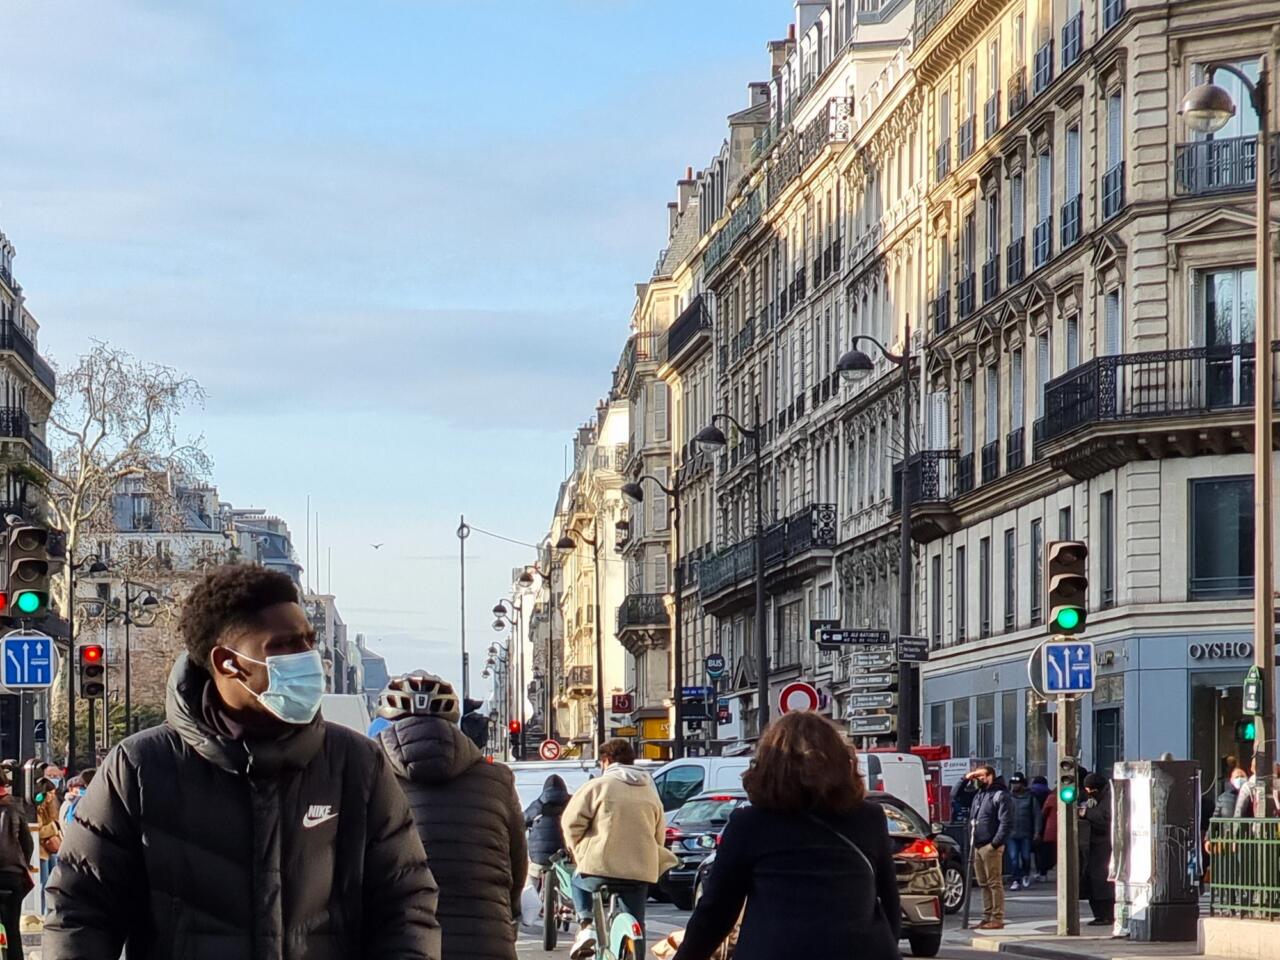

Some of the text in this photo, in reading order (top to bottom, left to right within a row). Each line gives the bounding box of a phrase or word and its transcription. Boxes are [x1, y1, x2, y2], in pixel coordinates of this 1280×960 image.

[1188, 642, 1251, 659] OYSHO
[708, 659, 723, 667] BUS
[308, 805, 332, 817] NIKE
